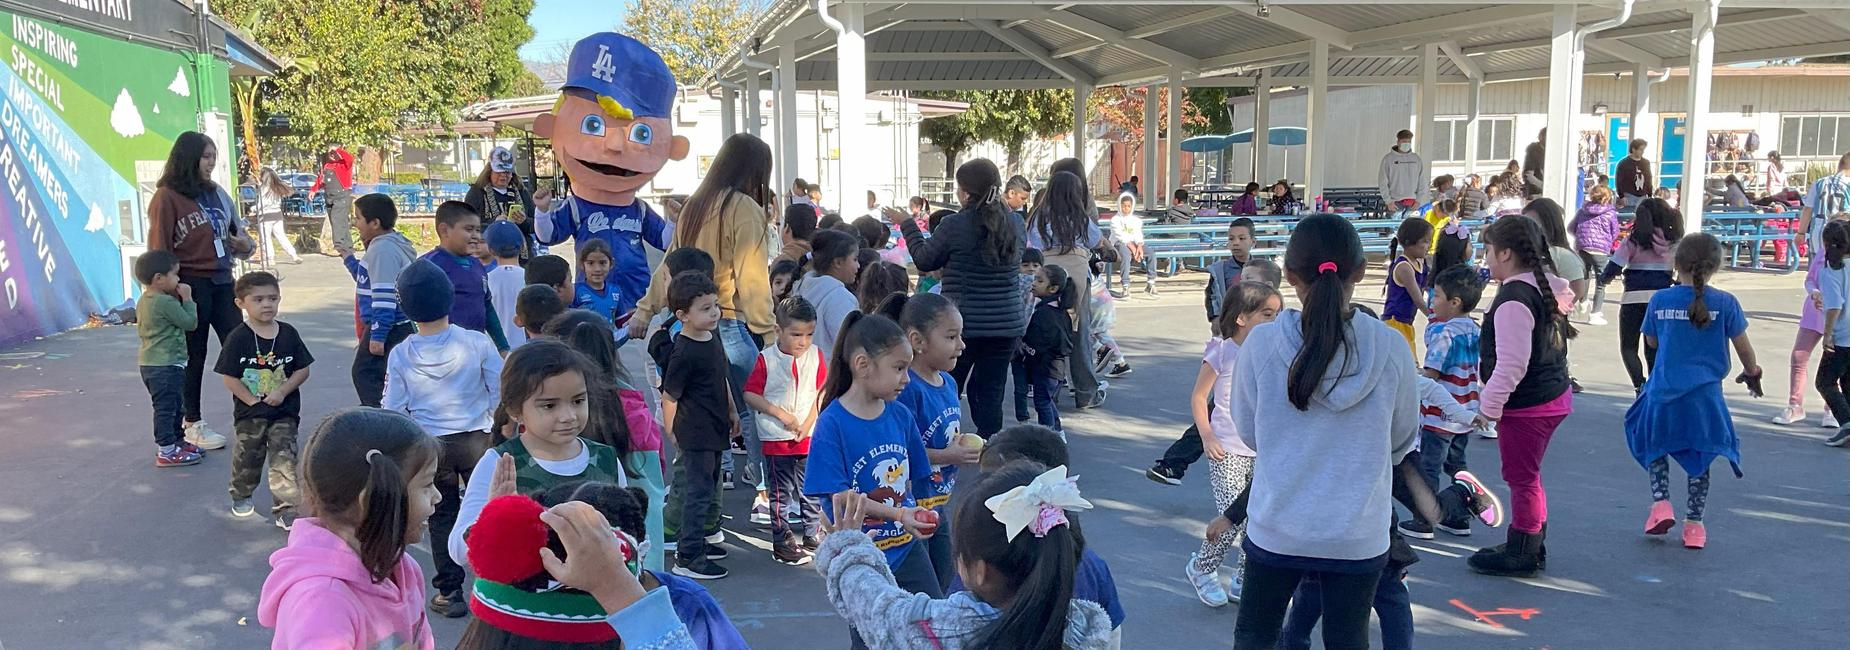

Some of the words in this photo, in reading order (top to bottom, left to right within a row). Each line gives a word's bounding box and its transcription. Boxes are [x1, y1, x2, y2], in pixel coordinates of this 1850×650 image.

[13, 14, 78, 68] INSPIRING
[592, 44, 617, 83] LA
[12, 44, 64, 112] SPECIAL
[8, 75, 81, 175] IMPORTANT
[2, 99, 69, 219] DREAMERS
[0, 127, 56, 283] REATIVE
[240, 356, 294, 366] FRND
[852, 456, 868, 492] STEET
